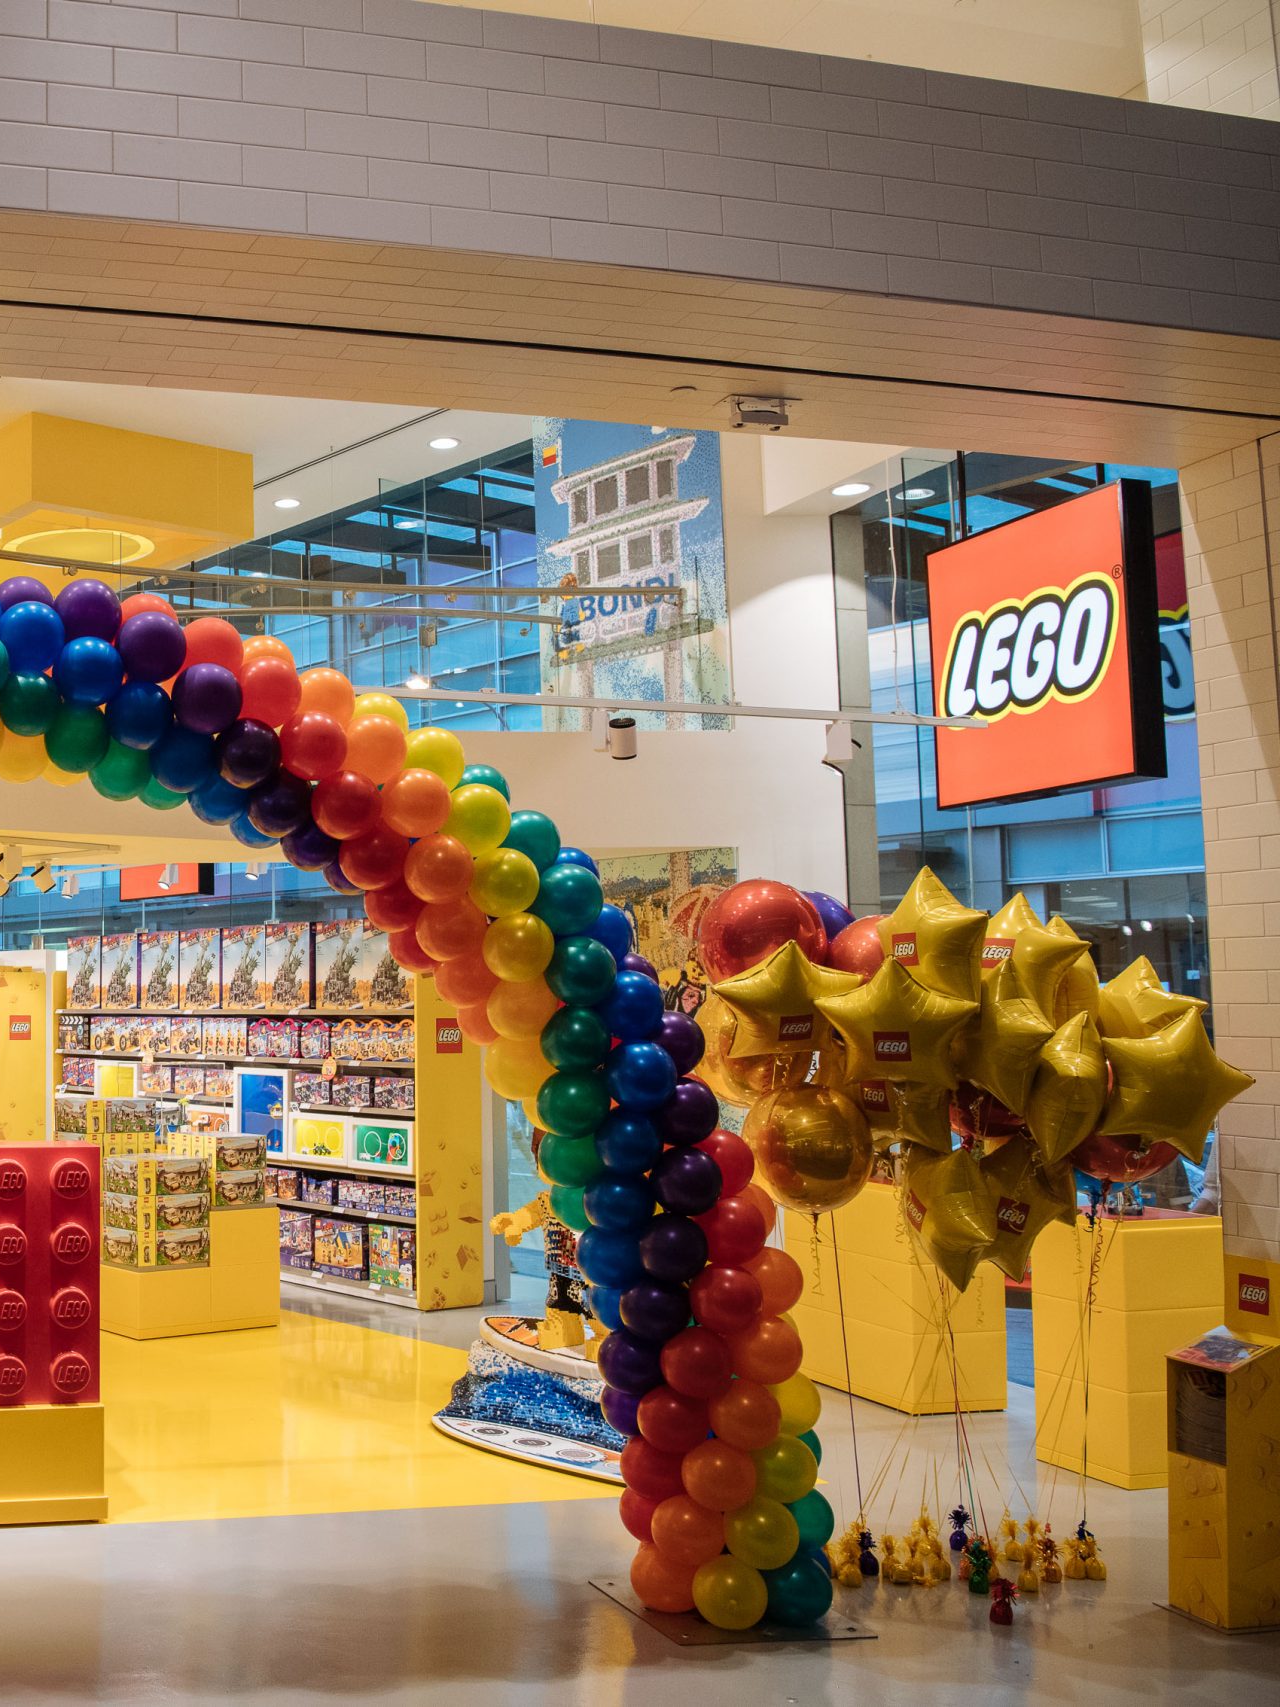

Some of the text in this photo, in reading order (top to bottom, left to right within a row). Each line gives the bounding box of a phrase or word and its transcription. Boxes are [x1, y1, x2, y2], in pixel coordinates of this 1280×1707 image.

[946, 583, 1112, 719] LEGO
[895, 943, 915, 956] LEGO
[982, 947, 1012, 959] LEGO
[11, 1023, 29, 1032] LEGO
[438, 1029, 460, 1042] LEGO
[782, 1022, 811, 1034] LEGO
[877, 1041, 908, 1053] LEGO
[864, 1090, 885, 1103] LEGO
[58, 1171, 87, 1188] LEGO
[906, 1201, 923, 1223] LEGO
[998, 1208, 1026, 1225] LEGO
[58, 1235, 87, 1253] LEGO
[1241, 1286, 1267, 1302] LEGO
[58, 1301, 87, 1317] LEGO
[57, 1365, 87, 1383] LEGO
